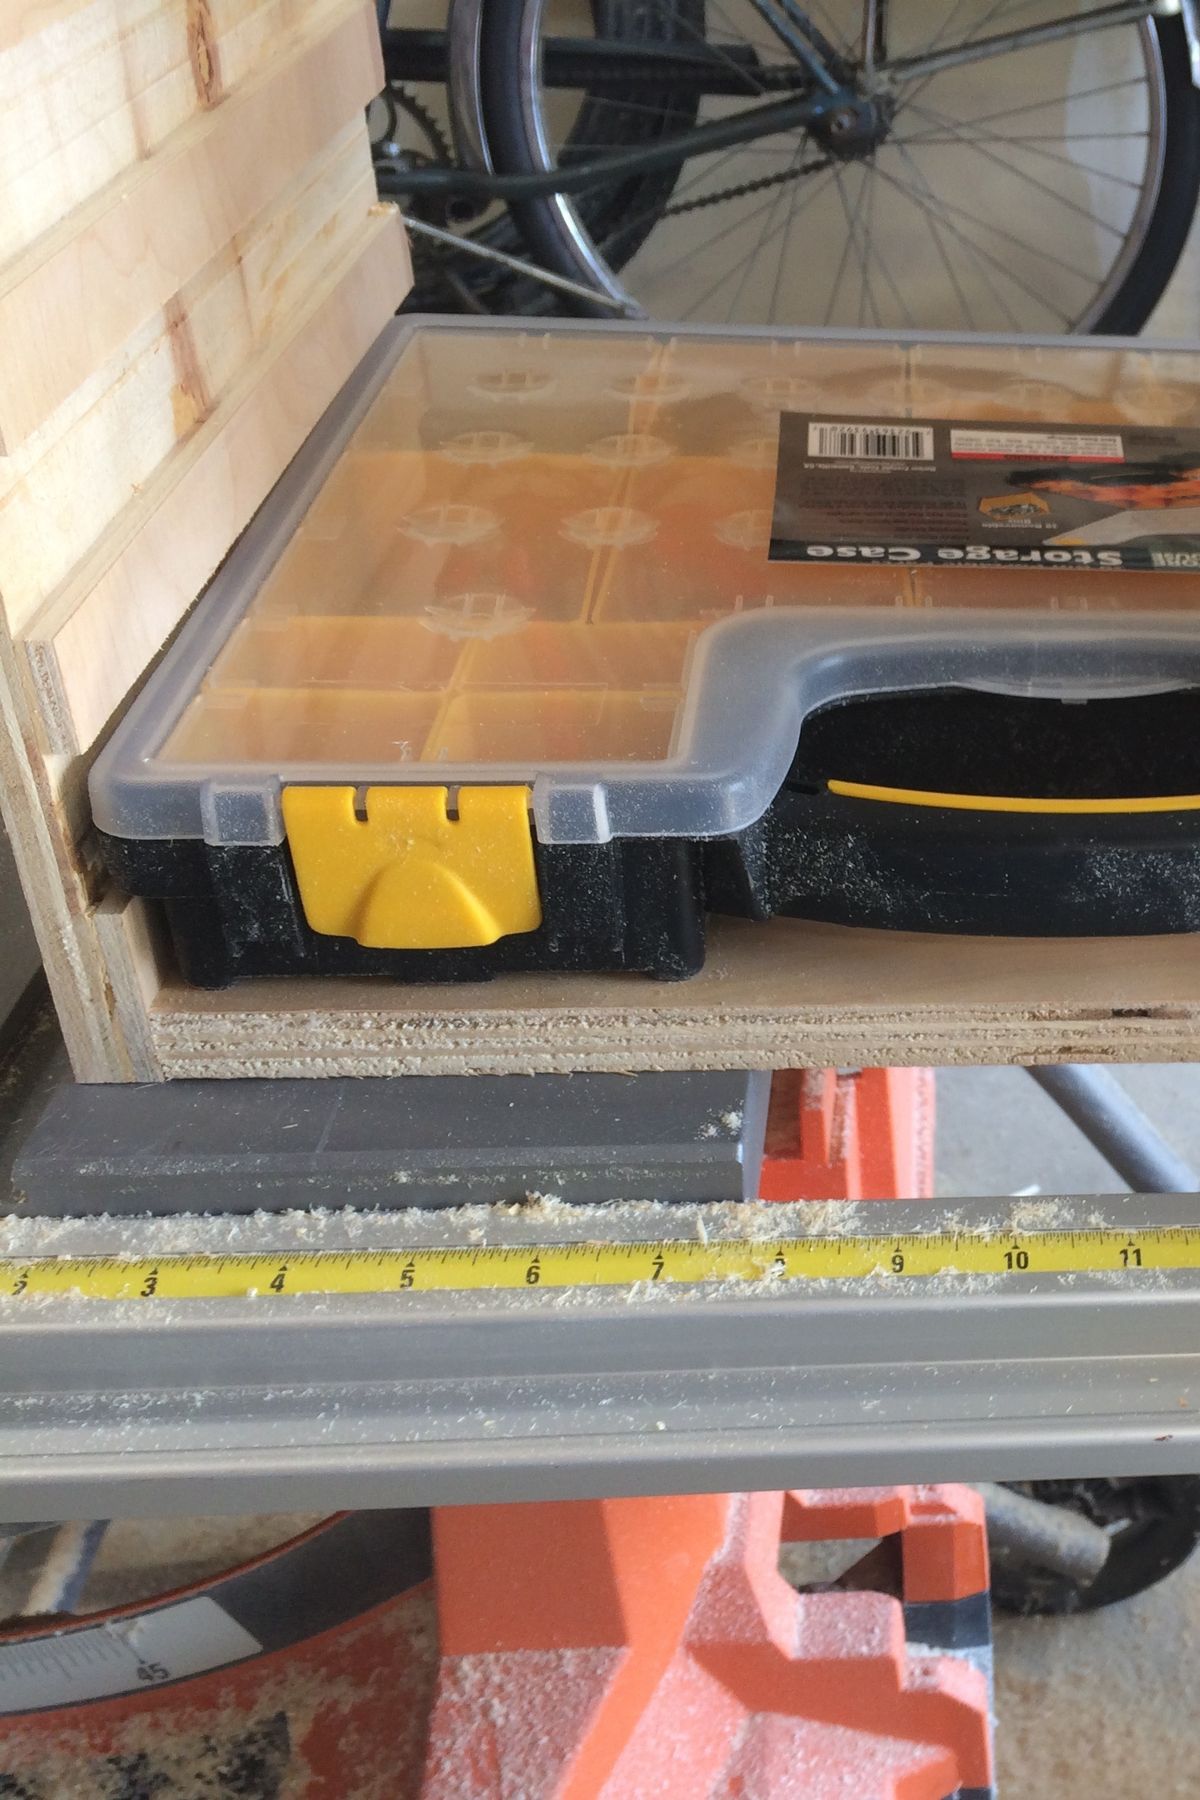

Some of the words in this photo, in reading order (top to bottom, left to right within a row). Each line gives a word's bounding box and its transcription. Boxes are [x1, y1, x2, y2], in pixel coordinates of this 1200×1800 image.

[806, 545, 921, 561] Case
[937, 545, 1123, 566] Storage
[140, 1276, 158, 1297] 3
[269, 1273, 286, 1293] 4
[399, 1269, 416, 1289] 5
[525, 1265, 541, 1285] 6
[651, 1261, 665, 1281] 7
[891, 1254, 905, 1273] 9
[1003, 1251, 1029, 1270] 10
[1119, 1248, 1142, 1267] 11
